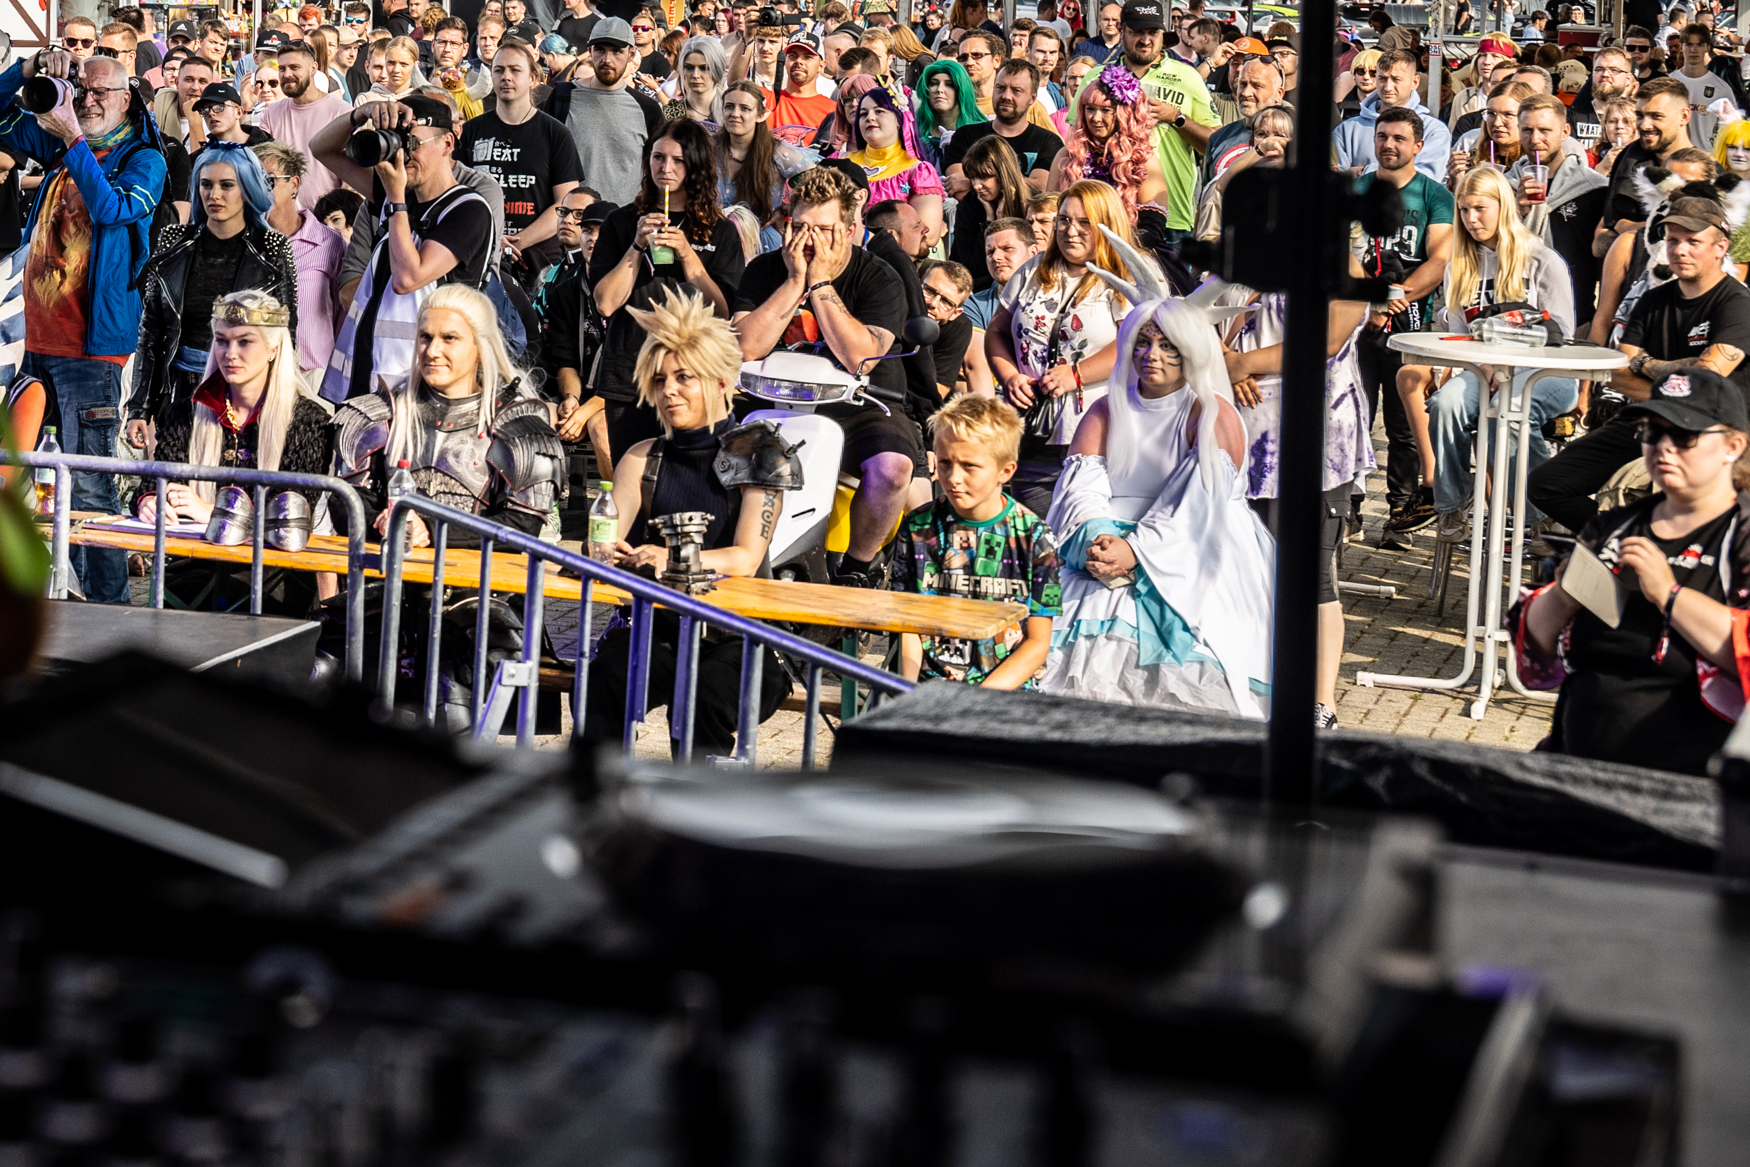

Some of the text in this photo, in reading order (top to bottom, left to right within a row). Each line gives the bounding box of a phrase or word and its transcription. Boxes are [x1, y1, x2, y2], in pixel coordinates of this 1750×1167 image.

[492, 148, 521, 162] EAT
[504, 201, 535, 215] NIME
[922, 572, 1029, 599] MINECRAFT
